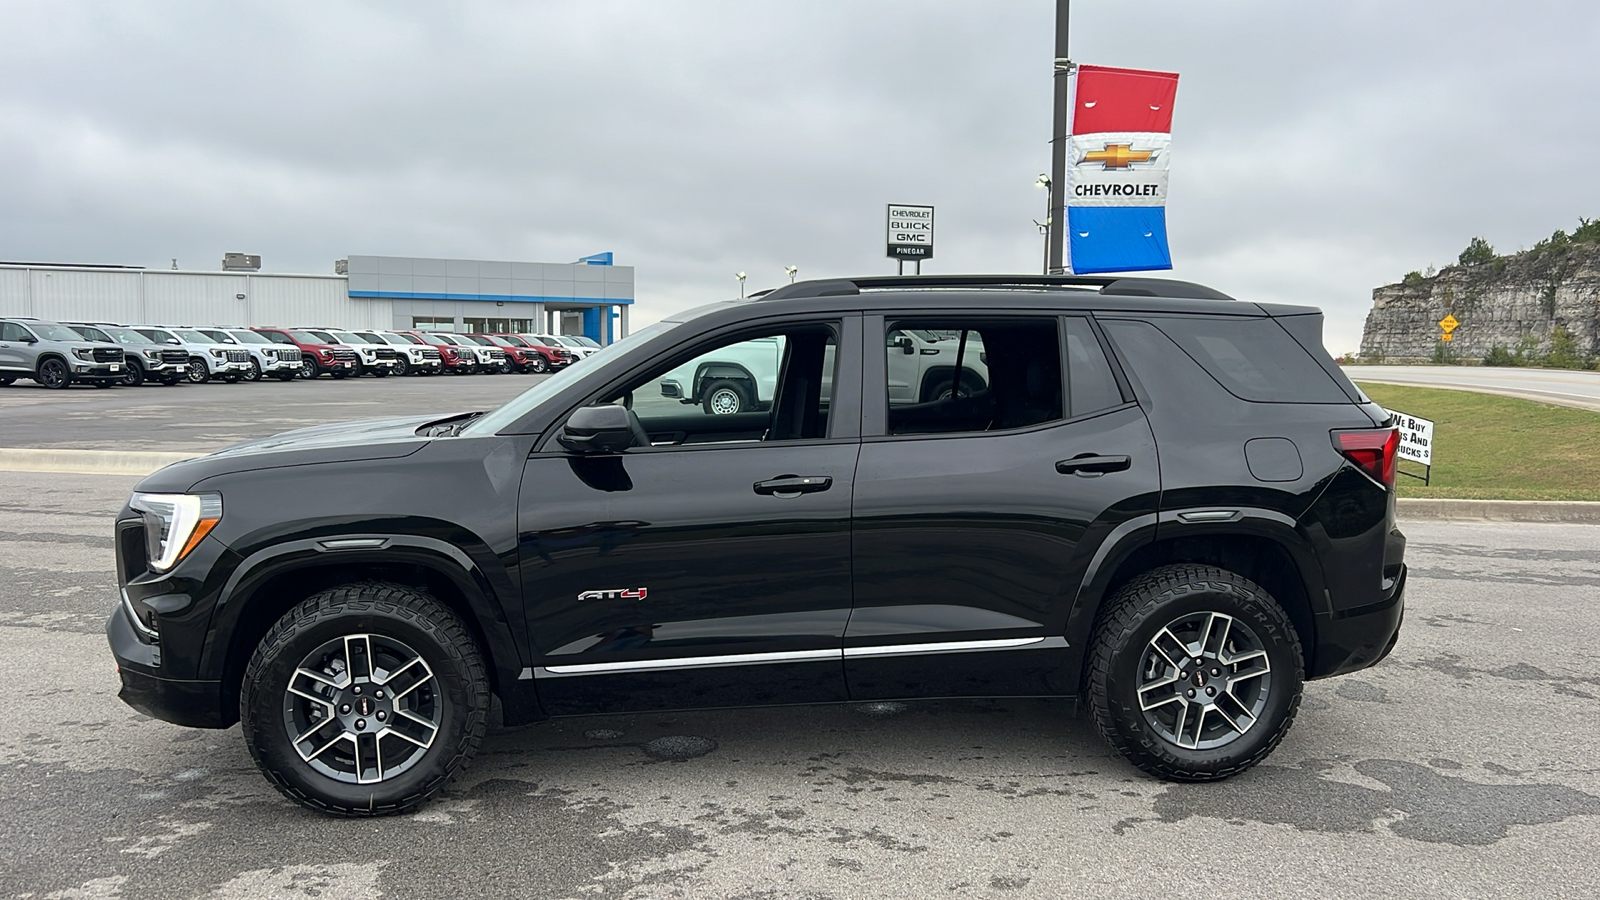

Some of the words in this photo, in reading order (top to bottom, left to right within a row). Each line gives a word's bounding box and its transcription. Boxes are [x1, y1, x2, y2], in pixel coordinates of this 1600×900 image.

[892, 210, 930, 218] CHEVROLET
[891, 221, 930, 230] BUICK
[896, 233, 925, 242] GMC
[896, 247, 925, 255] PINEGAR
[578, 587, 647, 600] AT4
